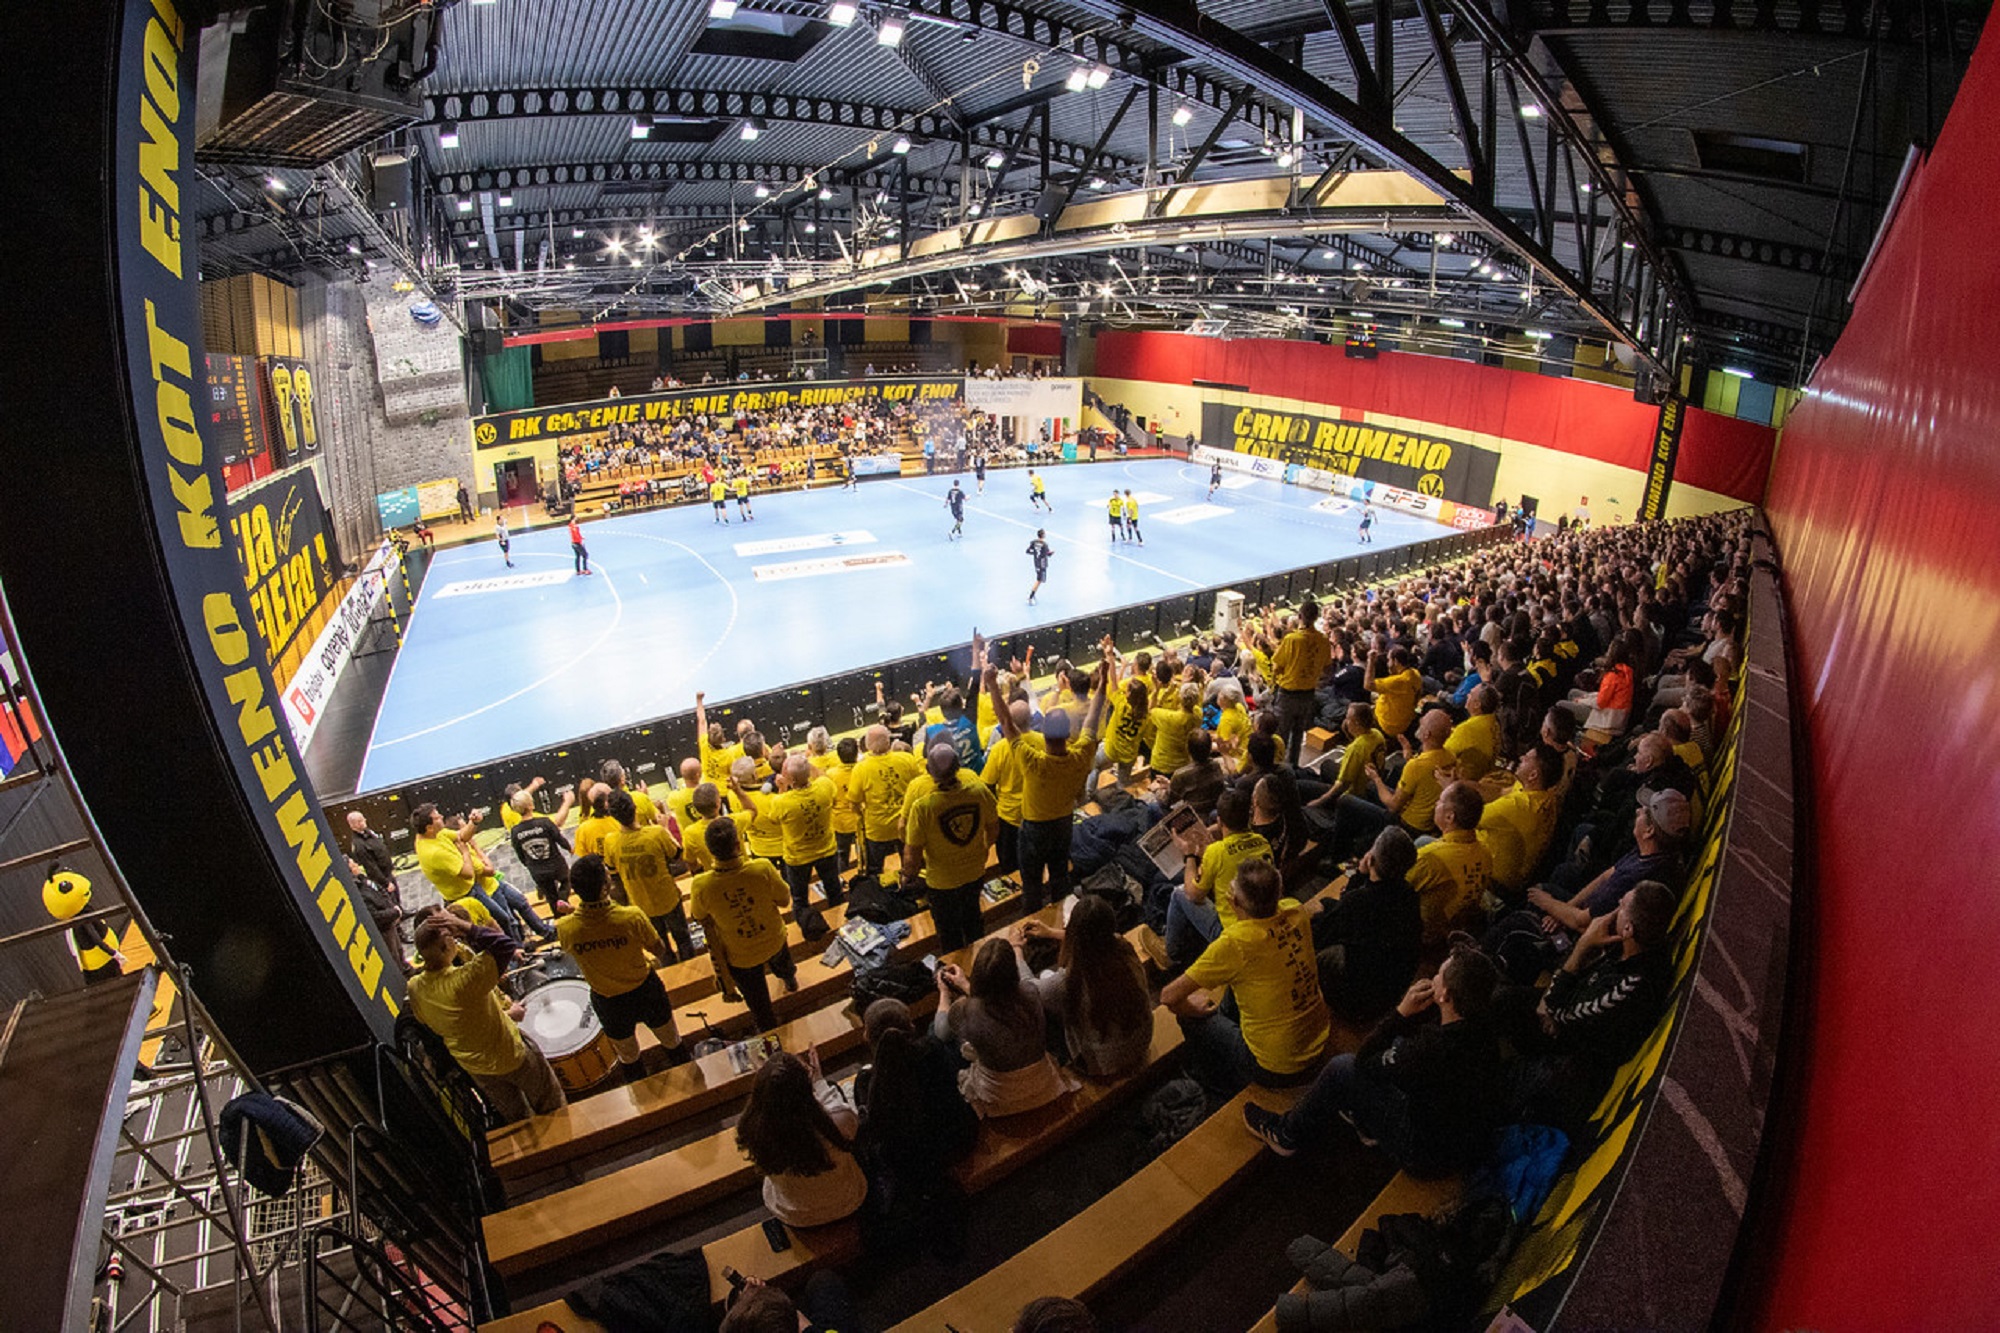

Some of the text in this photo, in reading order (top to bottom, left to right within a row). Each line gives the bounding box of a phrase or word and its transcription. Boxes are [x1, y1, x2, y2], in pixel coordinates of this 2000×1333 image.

[144, 298, 223, 548] KOT
[509, 415, 543, 440] RK
[882, 383, 916, 400] KOT
[1233, 406, 1452, 471] ČRNO RUMENO
[1657, 430, 1673, 462] KOT
[1456, 507, 1485, 520] radio
[573, 935, 629, 956] gorenje
